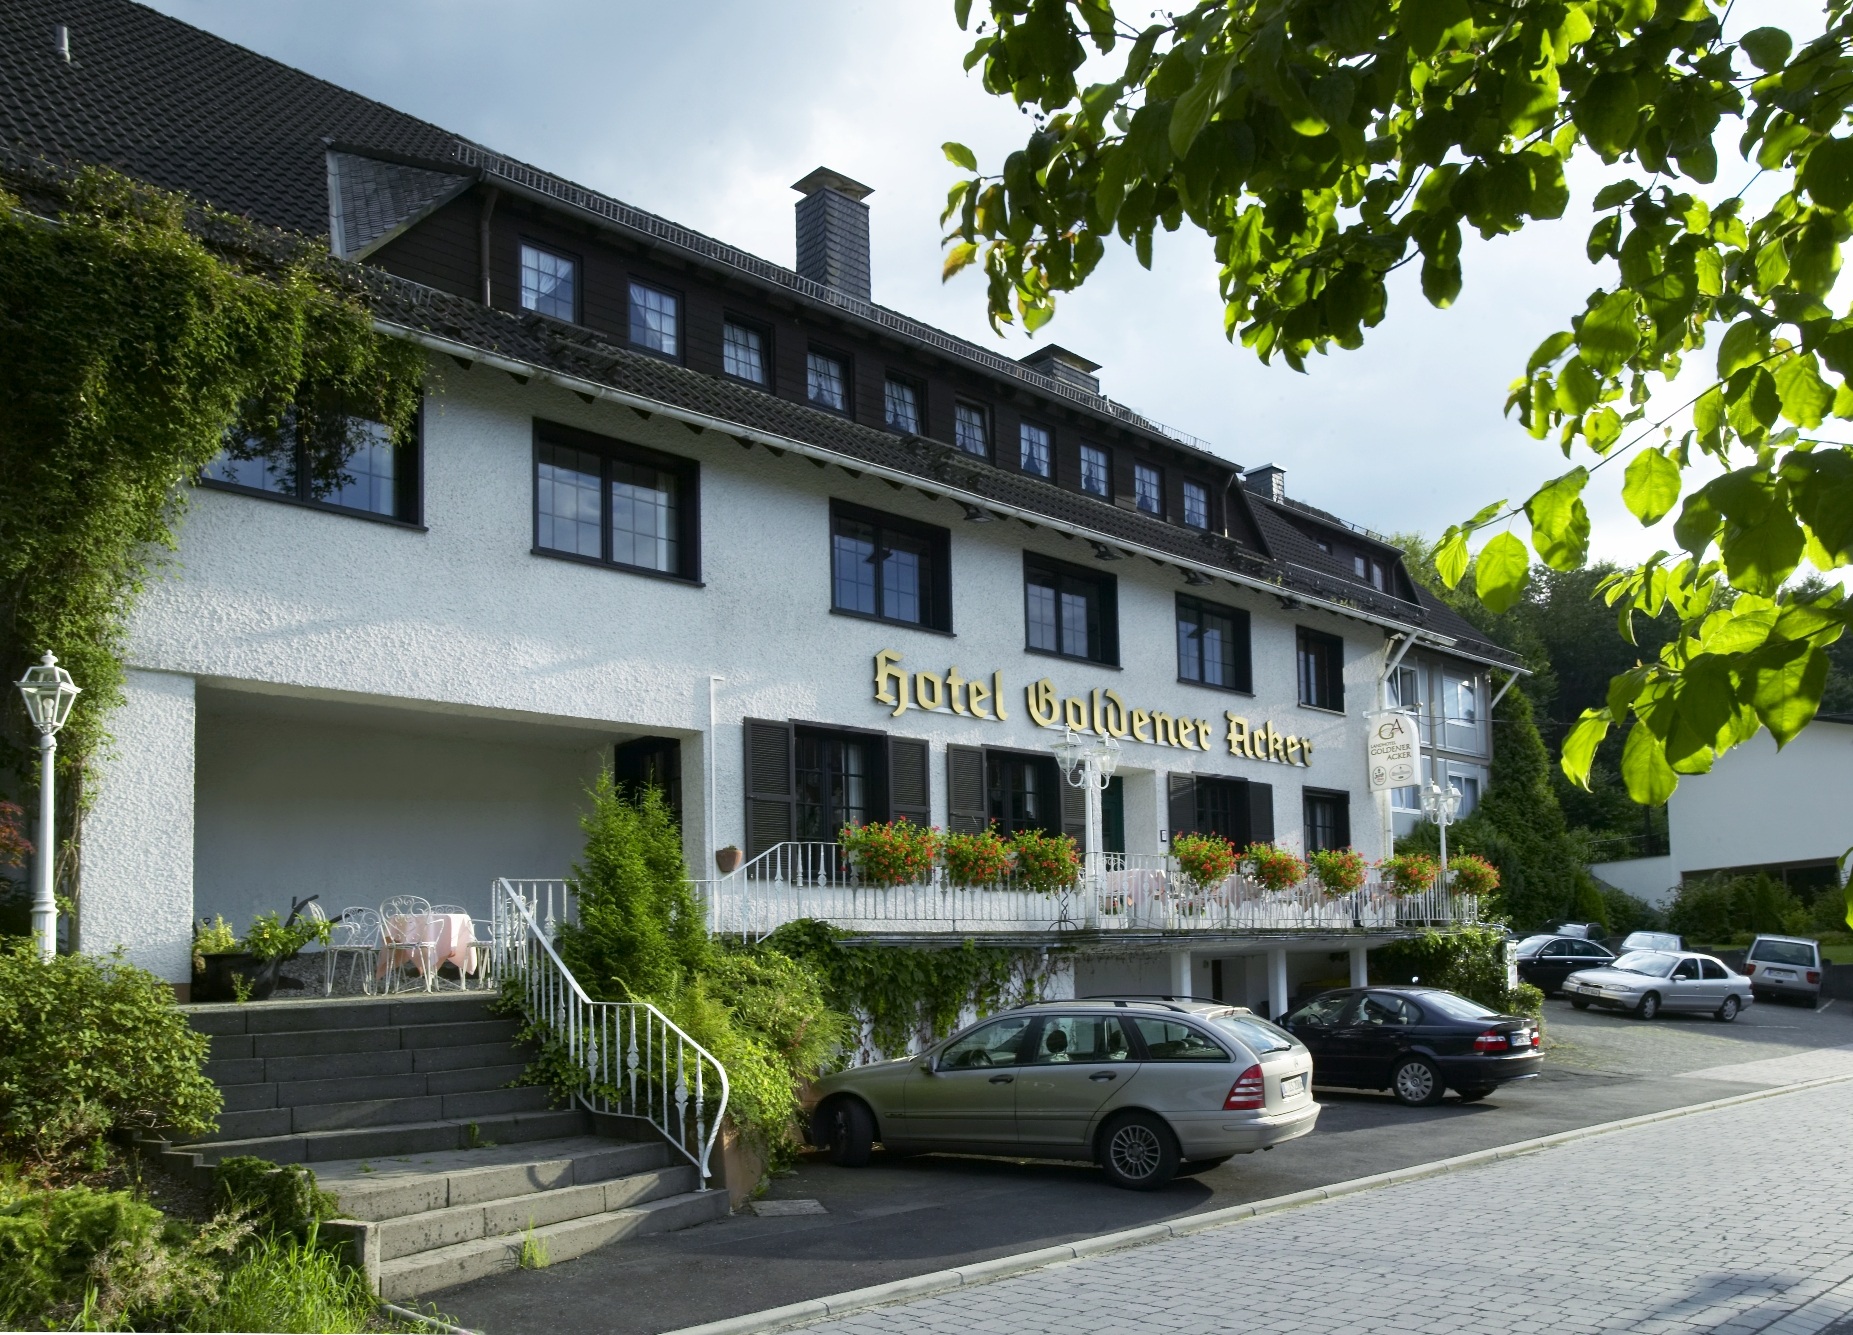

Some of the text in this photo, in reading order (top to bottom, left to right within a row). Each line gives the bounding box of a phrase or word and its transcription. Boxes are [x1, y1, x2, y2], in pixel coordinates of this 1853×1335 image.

[874, 649, 1314, 767] Hotel Goldener Acker
[1370, 744, 1411, 755] GOLDENER
[1387, 752, 1411, 760] ACKER
